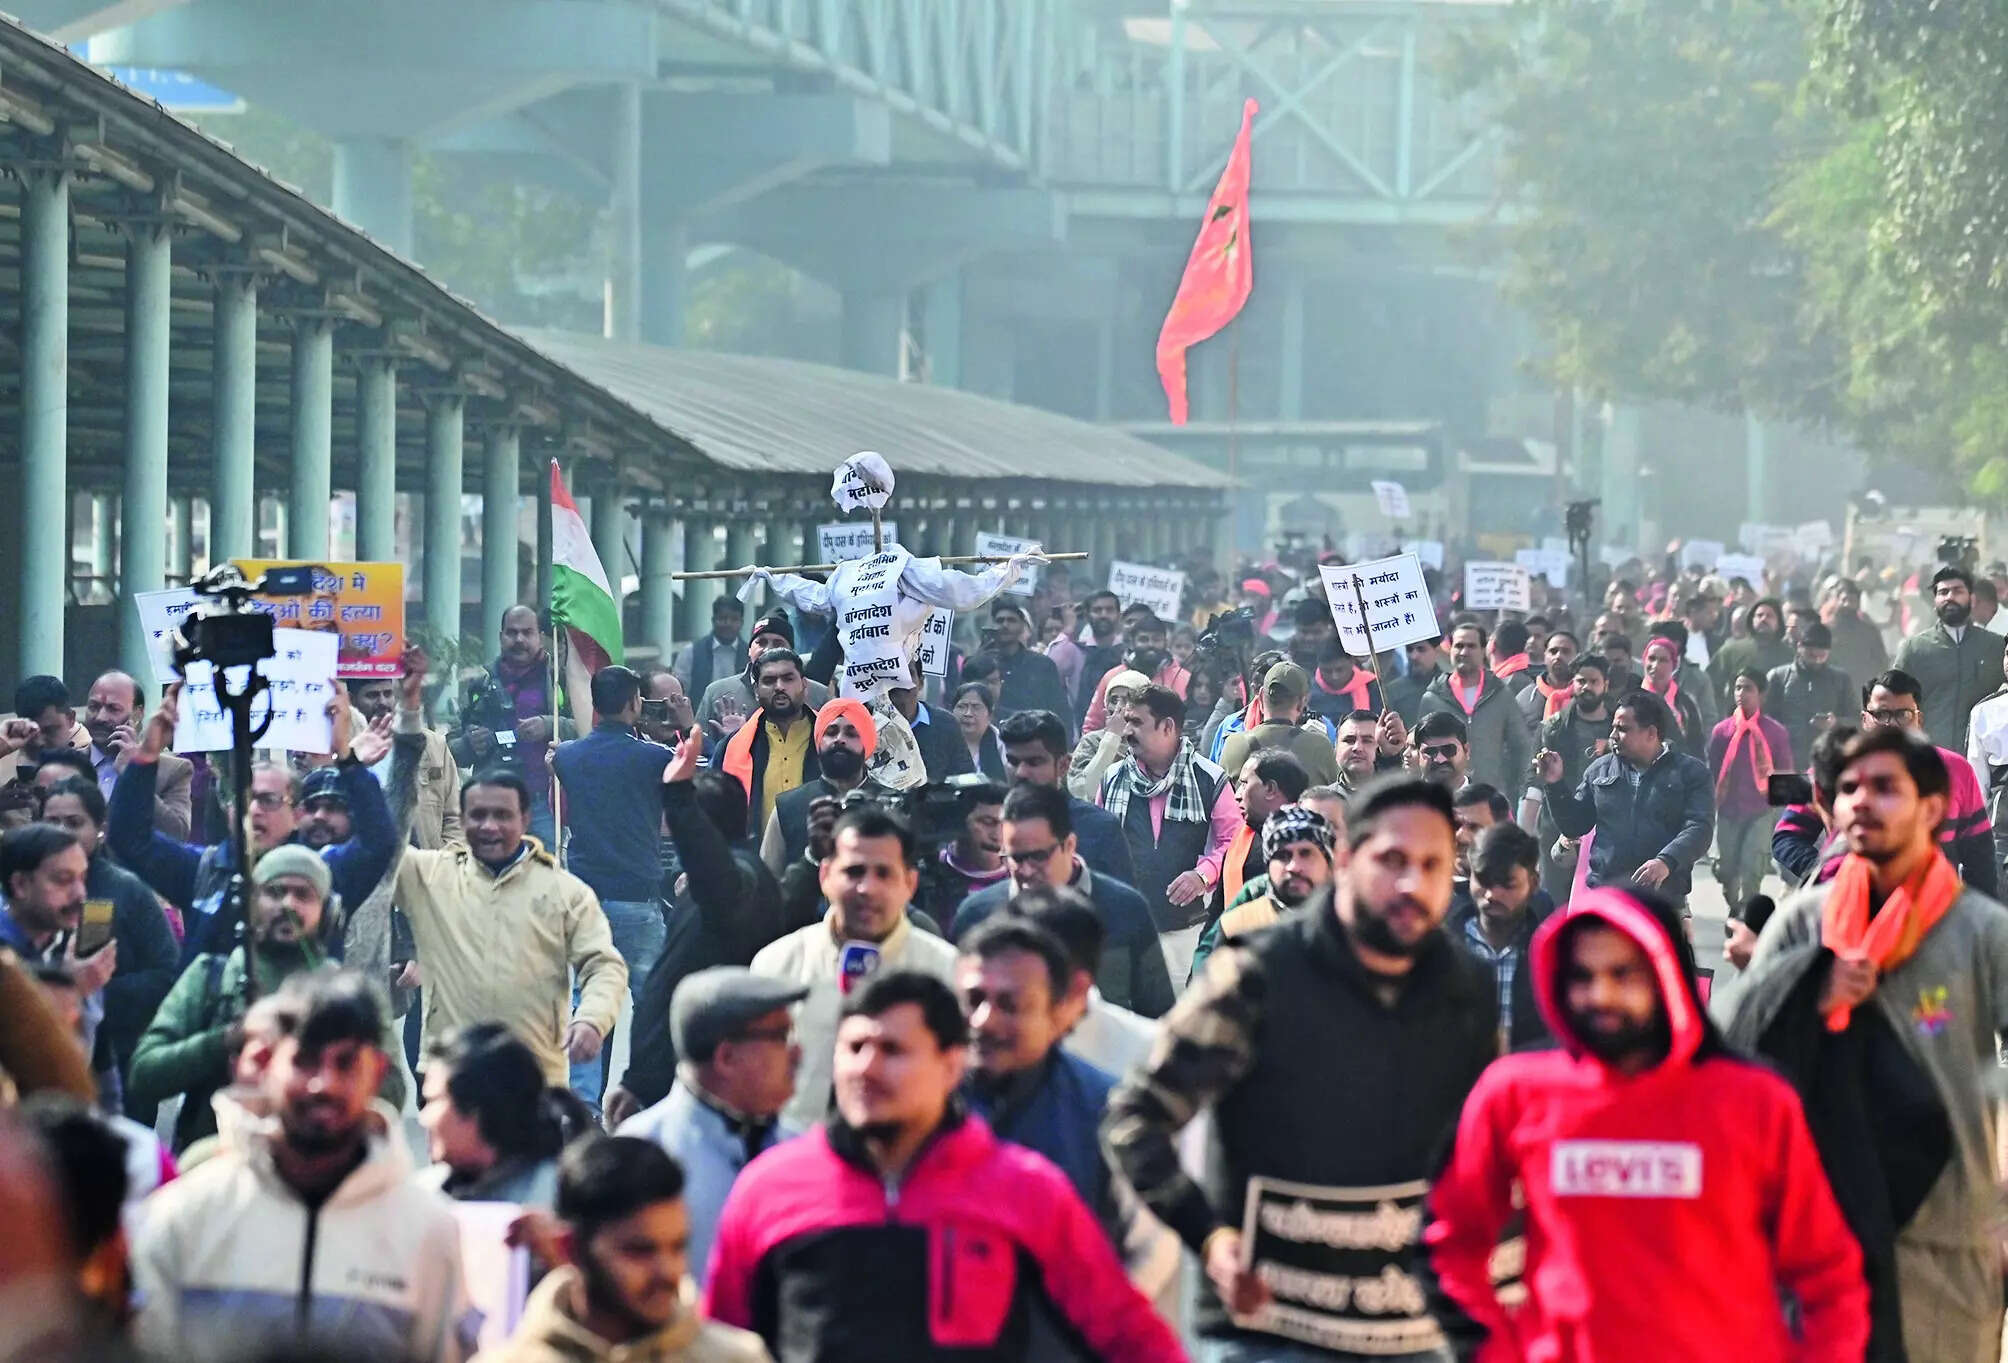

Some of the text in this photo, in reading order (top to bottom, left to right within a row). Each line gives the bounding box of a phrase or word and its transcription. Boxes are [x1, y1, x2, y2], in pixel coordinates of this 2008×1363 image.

[1369, 571, 1400, 585] मर्यादा
[1375, 591, 1400, 609] शस्त्रों
[1405, 590, 1418, 601] का
[341, 605, 381, 622] हत्या
[845, 604, 892, 624] बांग्लादेश
[1371, 616, 1400, 633] जानते
[850, 624, 890, 646] मुर्दाबाद
[846, 657, 900, 677] बांग्लादेश
